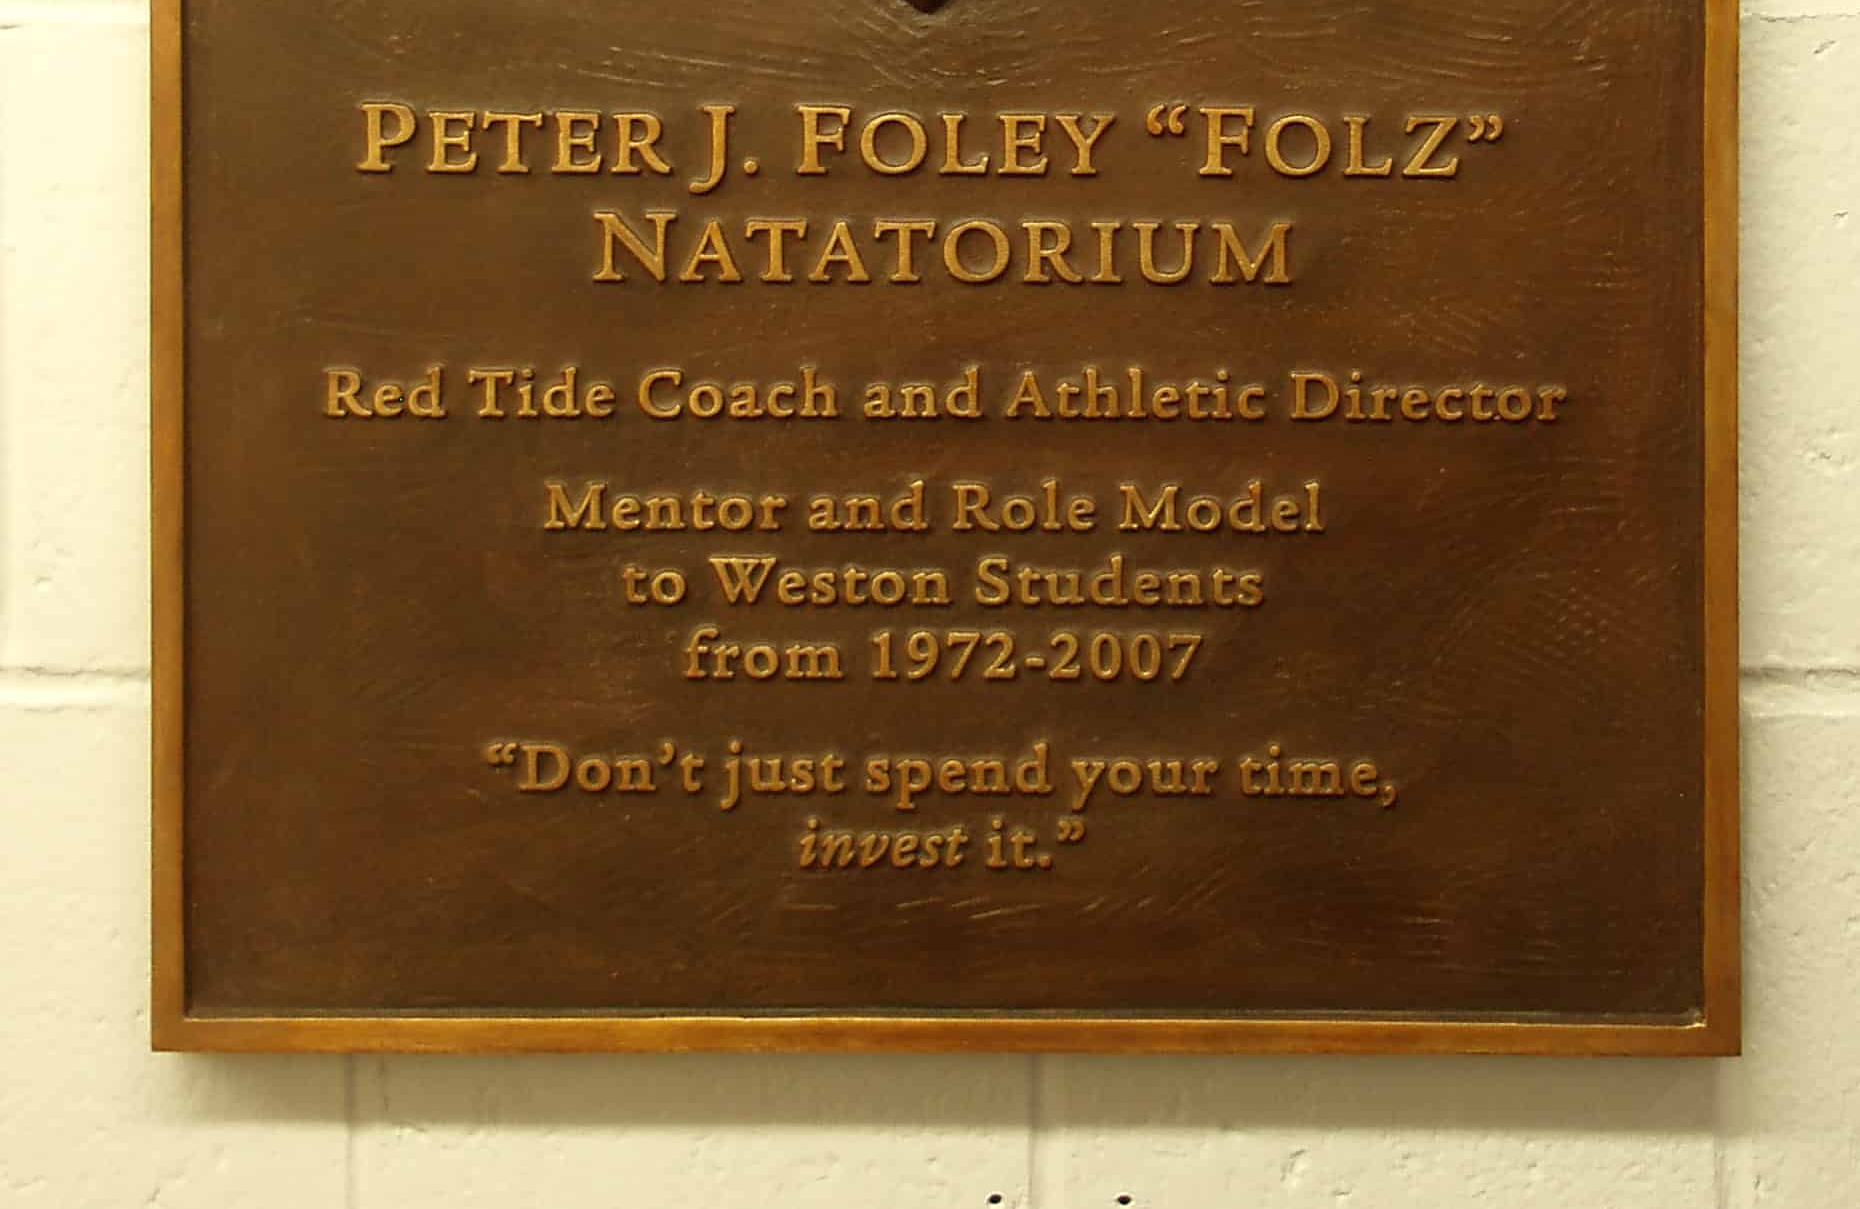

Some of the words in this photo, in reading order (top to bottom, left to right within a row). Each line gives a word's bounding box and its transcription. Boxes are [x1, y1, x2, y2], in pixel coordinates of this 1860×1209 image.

[325, 366, 446, 419] Red
[469, 366, 616, 419] Tide
[639, 367, 837, 419] Coach
[864, 366, 982, 419] and
[1007, 367, 1265, 420] Athletic
[1291, 370, 1567, 421] Director
[544, 481, 787, 531] Mentor
[808, 480, 928, 531] and
[952, 479, 1096, 532] Role
[1120, 480, 1324, 532] Model
[622, 565, 687, 605] to
[709, 556, 951, 605] Weston
[975, 554, 1265, 606] Students
[685, 628, 843, 679] from
[872, 631, 1201, 680] 1972-2007
[487, 743, 704, 792] “Don’t
[720, 742, 846, 810] just
[866, 742, 1052, 810] spend
[1072, 758, 1219, 810] your
[1240, 745, 1398, 807] time,
[800, 817, 969, 868] invest
[986, 817, 1086, 869] it.”
